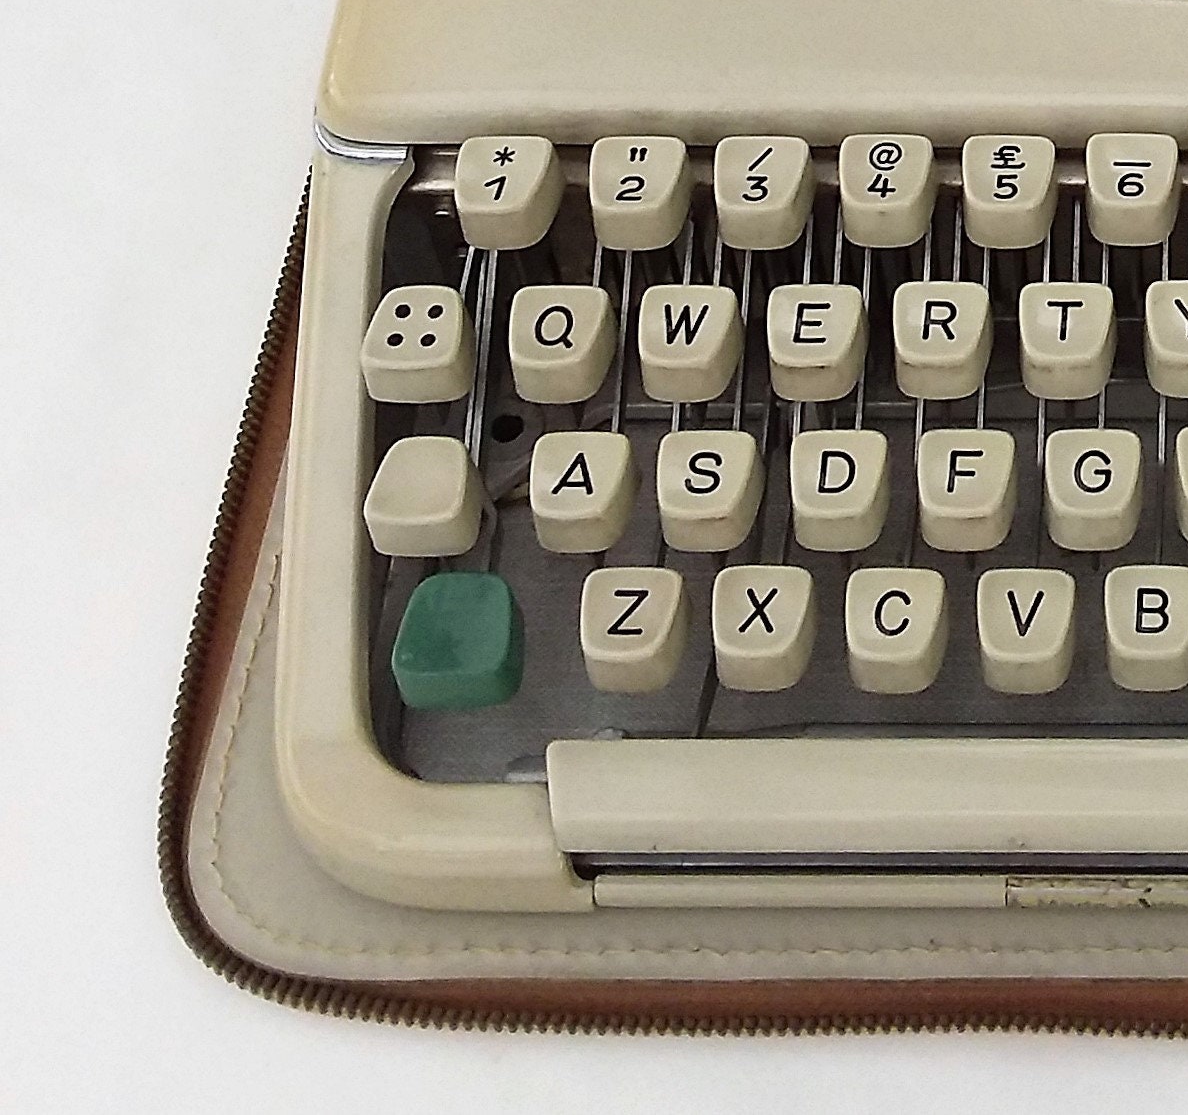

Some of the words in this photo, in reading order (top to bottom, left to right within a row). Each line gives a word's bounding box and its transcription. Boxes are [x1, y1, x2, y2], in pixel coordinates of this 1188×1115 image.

[868, 142, 903, 171] @
[990, 145, 1026, 170] £
[484, 175, 507, 201] 1
[615, 175, 645, 202] 2
[741, 175, 769, 202] 3
[867, 173, 897, 199] 4
[993, 174, 1019, 200] 5
[1117, 172, 1144, 197] 6
[534, 305, 574, 349] Q
[664, 303, 709, 346] W
[792, 302, 831, 344] E
[921, 300, 957, 341] R
[1046, 300, 1084, 341] T
[551, 452, 594, 496] A
[684, 451, 723, 495] S
[817, 450, 856, 494] D
[946, 450, 984, 493] F
[1073, 449, 1112, 494] G
[606, 589, 649, 636] Z
[738, 588, 778, 634] X
[874, 590, 911, 637] C
[1007, 590, 1045, 637] V
[1135, 587, 1169, 634] B
